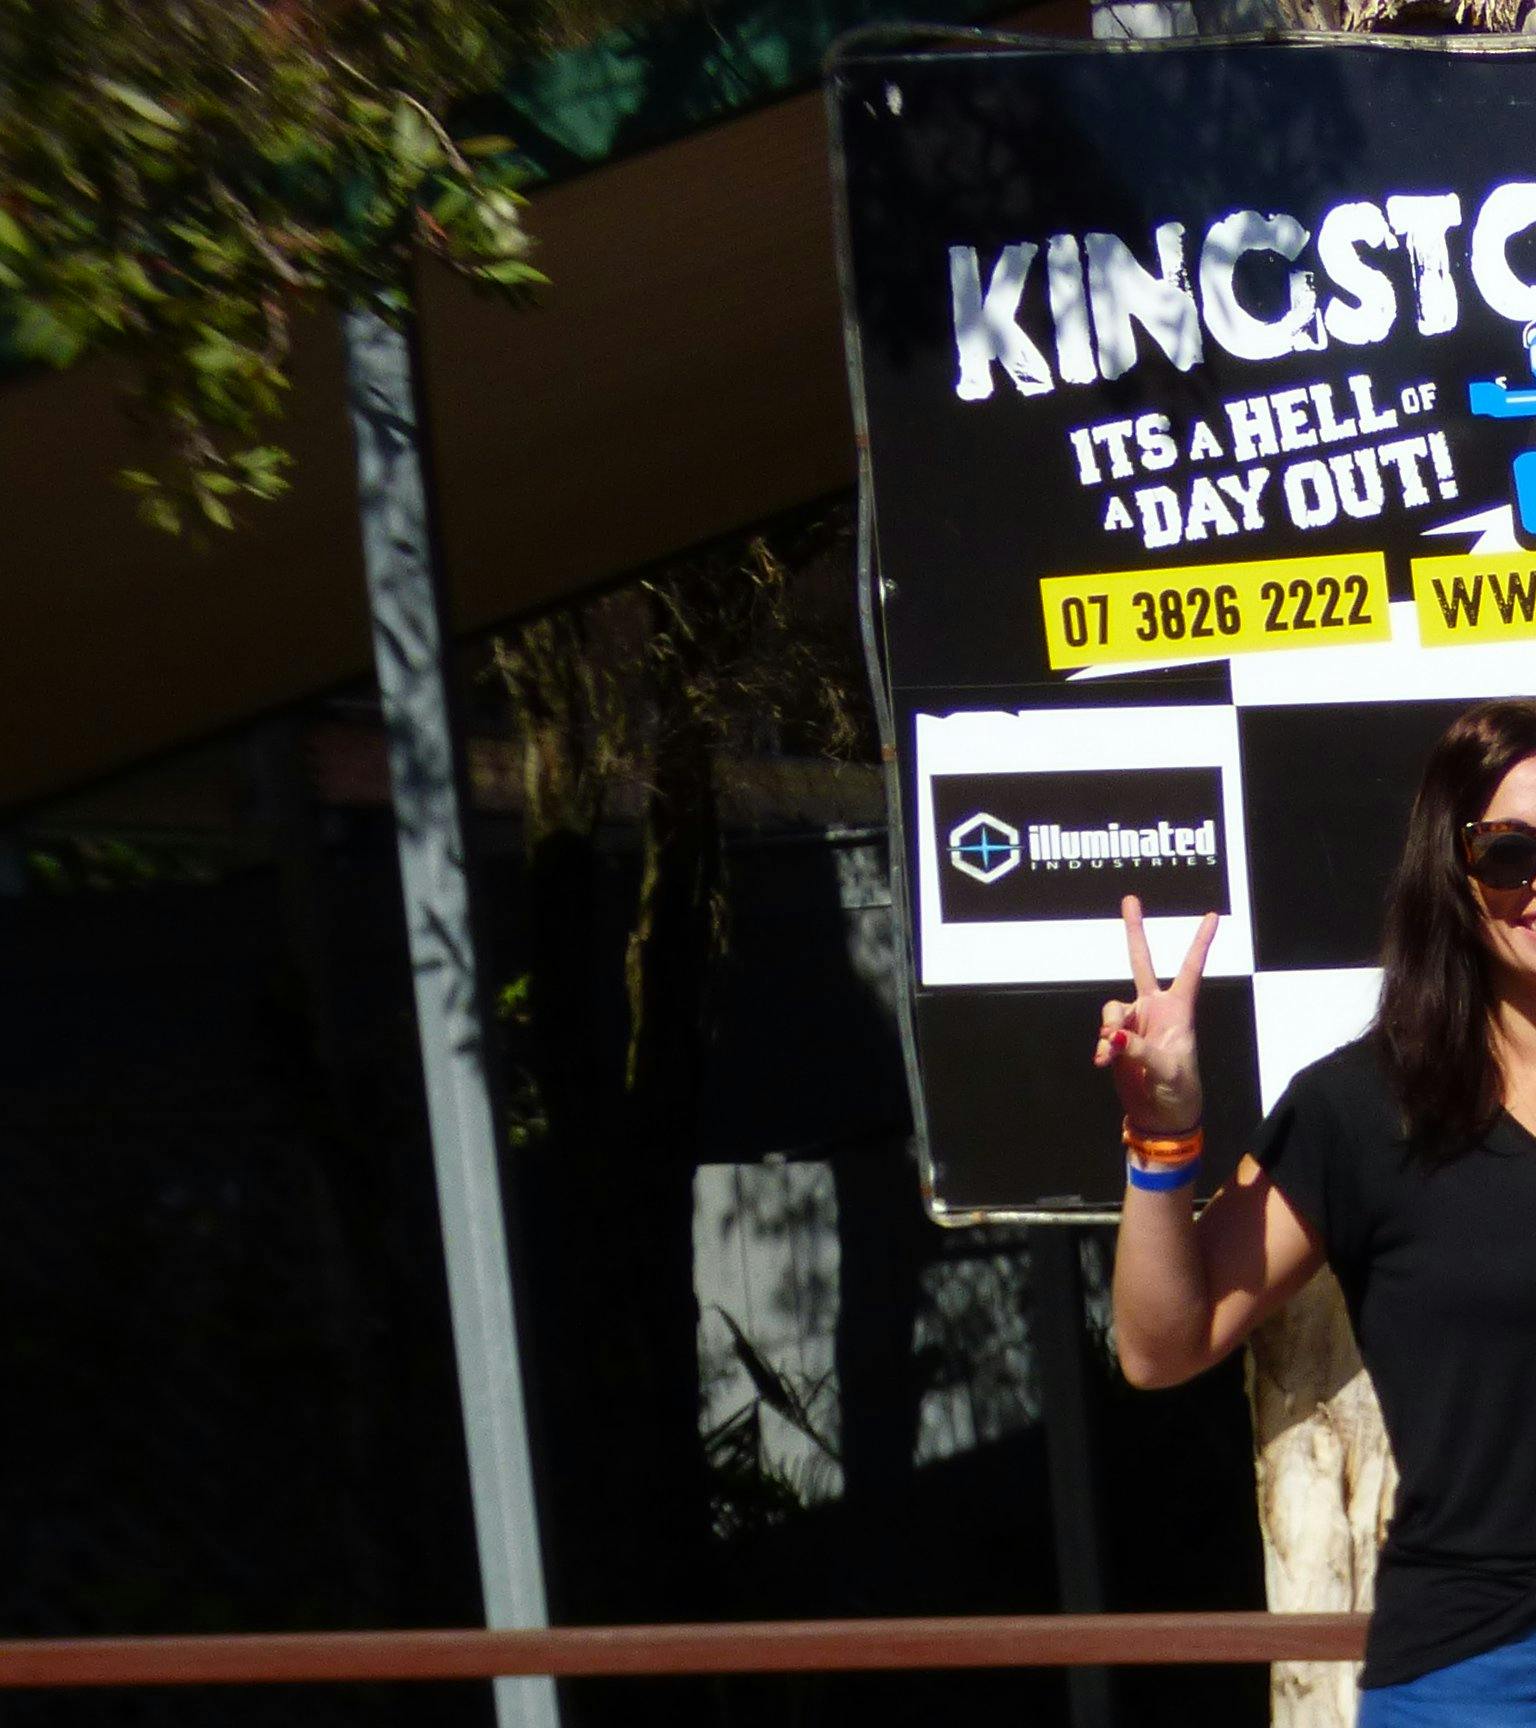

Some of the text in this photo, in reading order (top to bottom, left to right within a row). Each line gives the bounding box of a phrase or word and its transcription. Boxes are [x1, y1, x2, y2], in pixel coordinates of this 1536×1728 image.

[1189, 421, 1224, 462] A
[1224, 374, 1400, 463] HELL
[1401, 382, 1438, 414] OF
[1103, 432, 1460, 549] A DAY OUT!
[1061, 574, 1372, 648] 07 3826 2222
[1028, 819, 1216, 861] illuminated
[1031, 854, 1219, 871] INDUSTRIES
